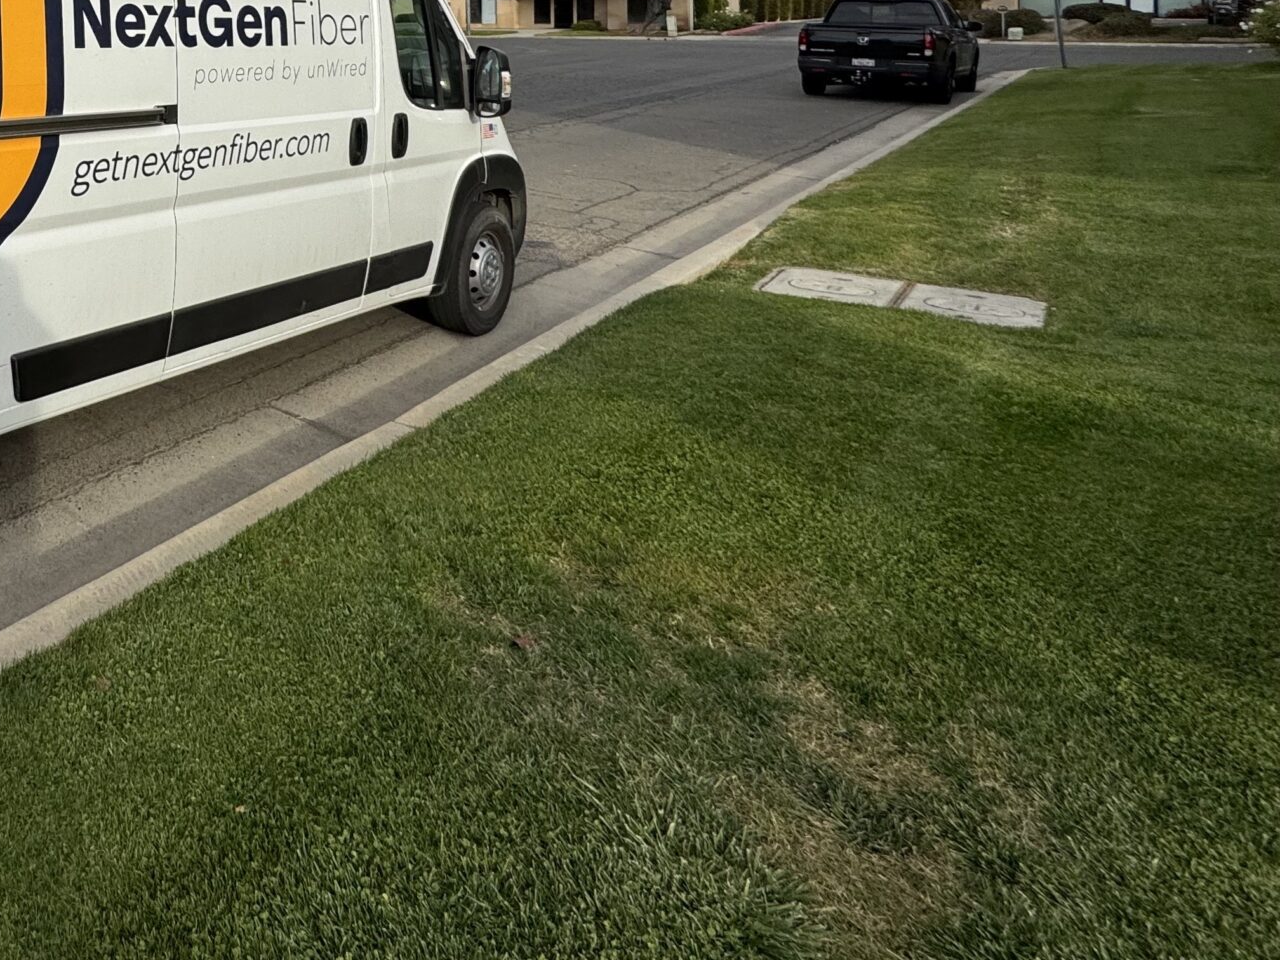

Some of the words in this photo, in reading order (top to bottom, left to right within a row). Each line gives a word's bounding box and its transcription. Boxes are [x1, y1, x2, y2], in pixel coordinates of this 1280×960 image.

[194, 59, 275, 90] powered
[282, 59, 300, 84] by
[307, 56, 367, 79] unWired
[71, 132, 330, 197] getnextgenfiber.com
